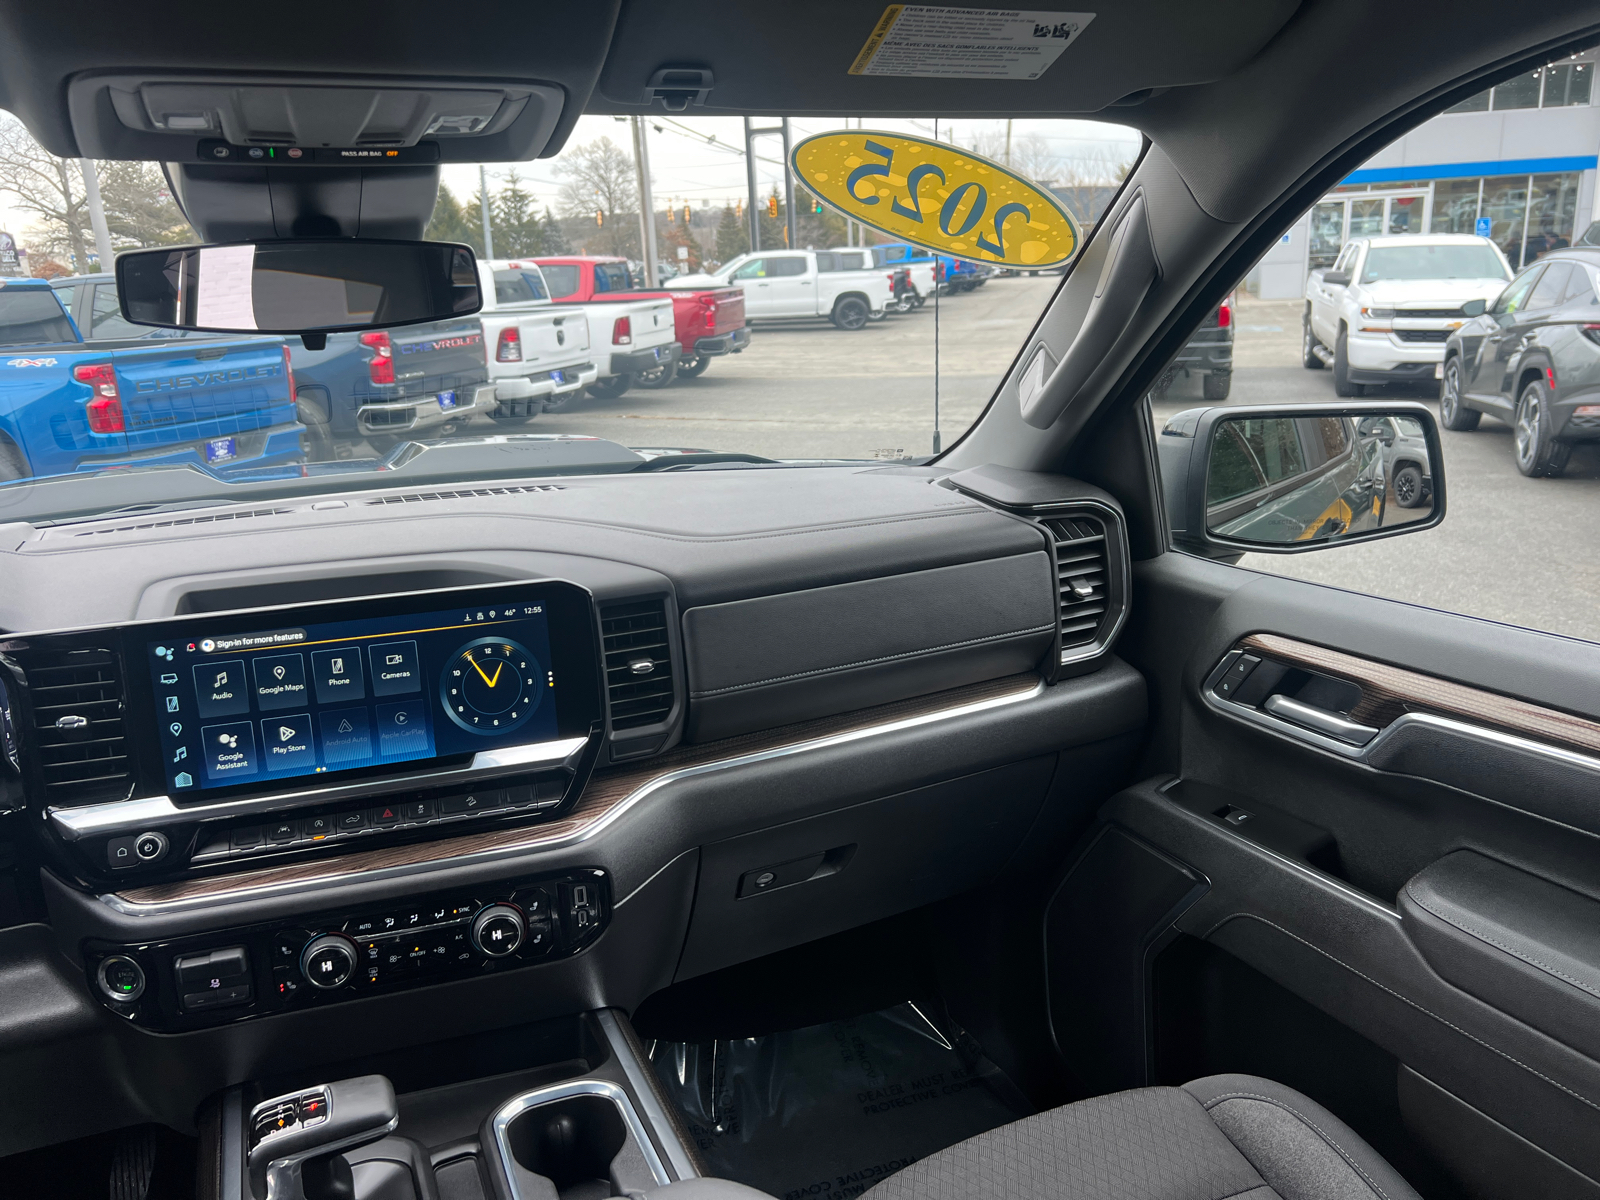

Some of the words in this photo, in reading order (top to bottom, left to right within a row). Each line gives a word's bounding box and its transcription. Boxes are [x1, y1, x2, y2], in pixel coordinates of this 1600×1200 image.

[401, 334, 481, 354] CHEVROLET
[136, 365, 280, 394] CHEVROLET
[524, 606, 542, 615] 12:55
[217, 639, 242, 649] Sign-in
[242, 637, 254, 646] for
[254, 636, 273, 645] more
[274, 632, 304, 642] features
[381, 671, 411, 680] Cameras
[328, 678, 350, 686] Phone
[259, 685, 284, 695] Google
[285, 683, 305, 692] Maps
[212, 691, 233, 700] Audio
[511, 711, 517, 719] 5
[381, 731, 400, 739] Apple
[400, 728, 425, 737] CarPlay
[325, 737, 351, 746] Android
[273, 745, 287, 754] Play
[288, 744, 306, 752] Store
[218, 752, 244, 762] Google
[216, 760, 248, 770] Assistant
[492, 929, 502, 941] HI
[321, 960, 333, 972] HI
[857, 1083, 905, 1104] DEALER
[911, 1073, 946, 1091] MUST
[863, 1090, 938, 1116] PROTECTIVE
[836, 1155, 917, 1187] PROTECTIVE
[784, 1181, 832, 1200] COVER
